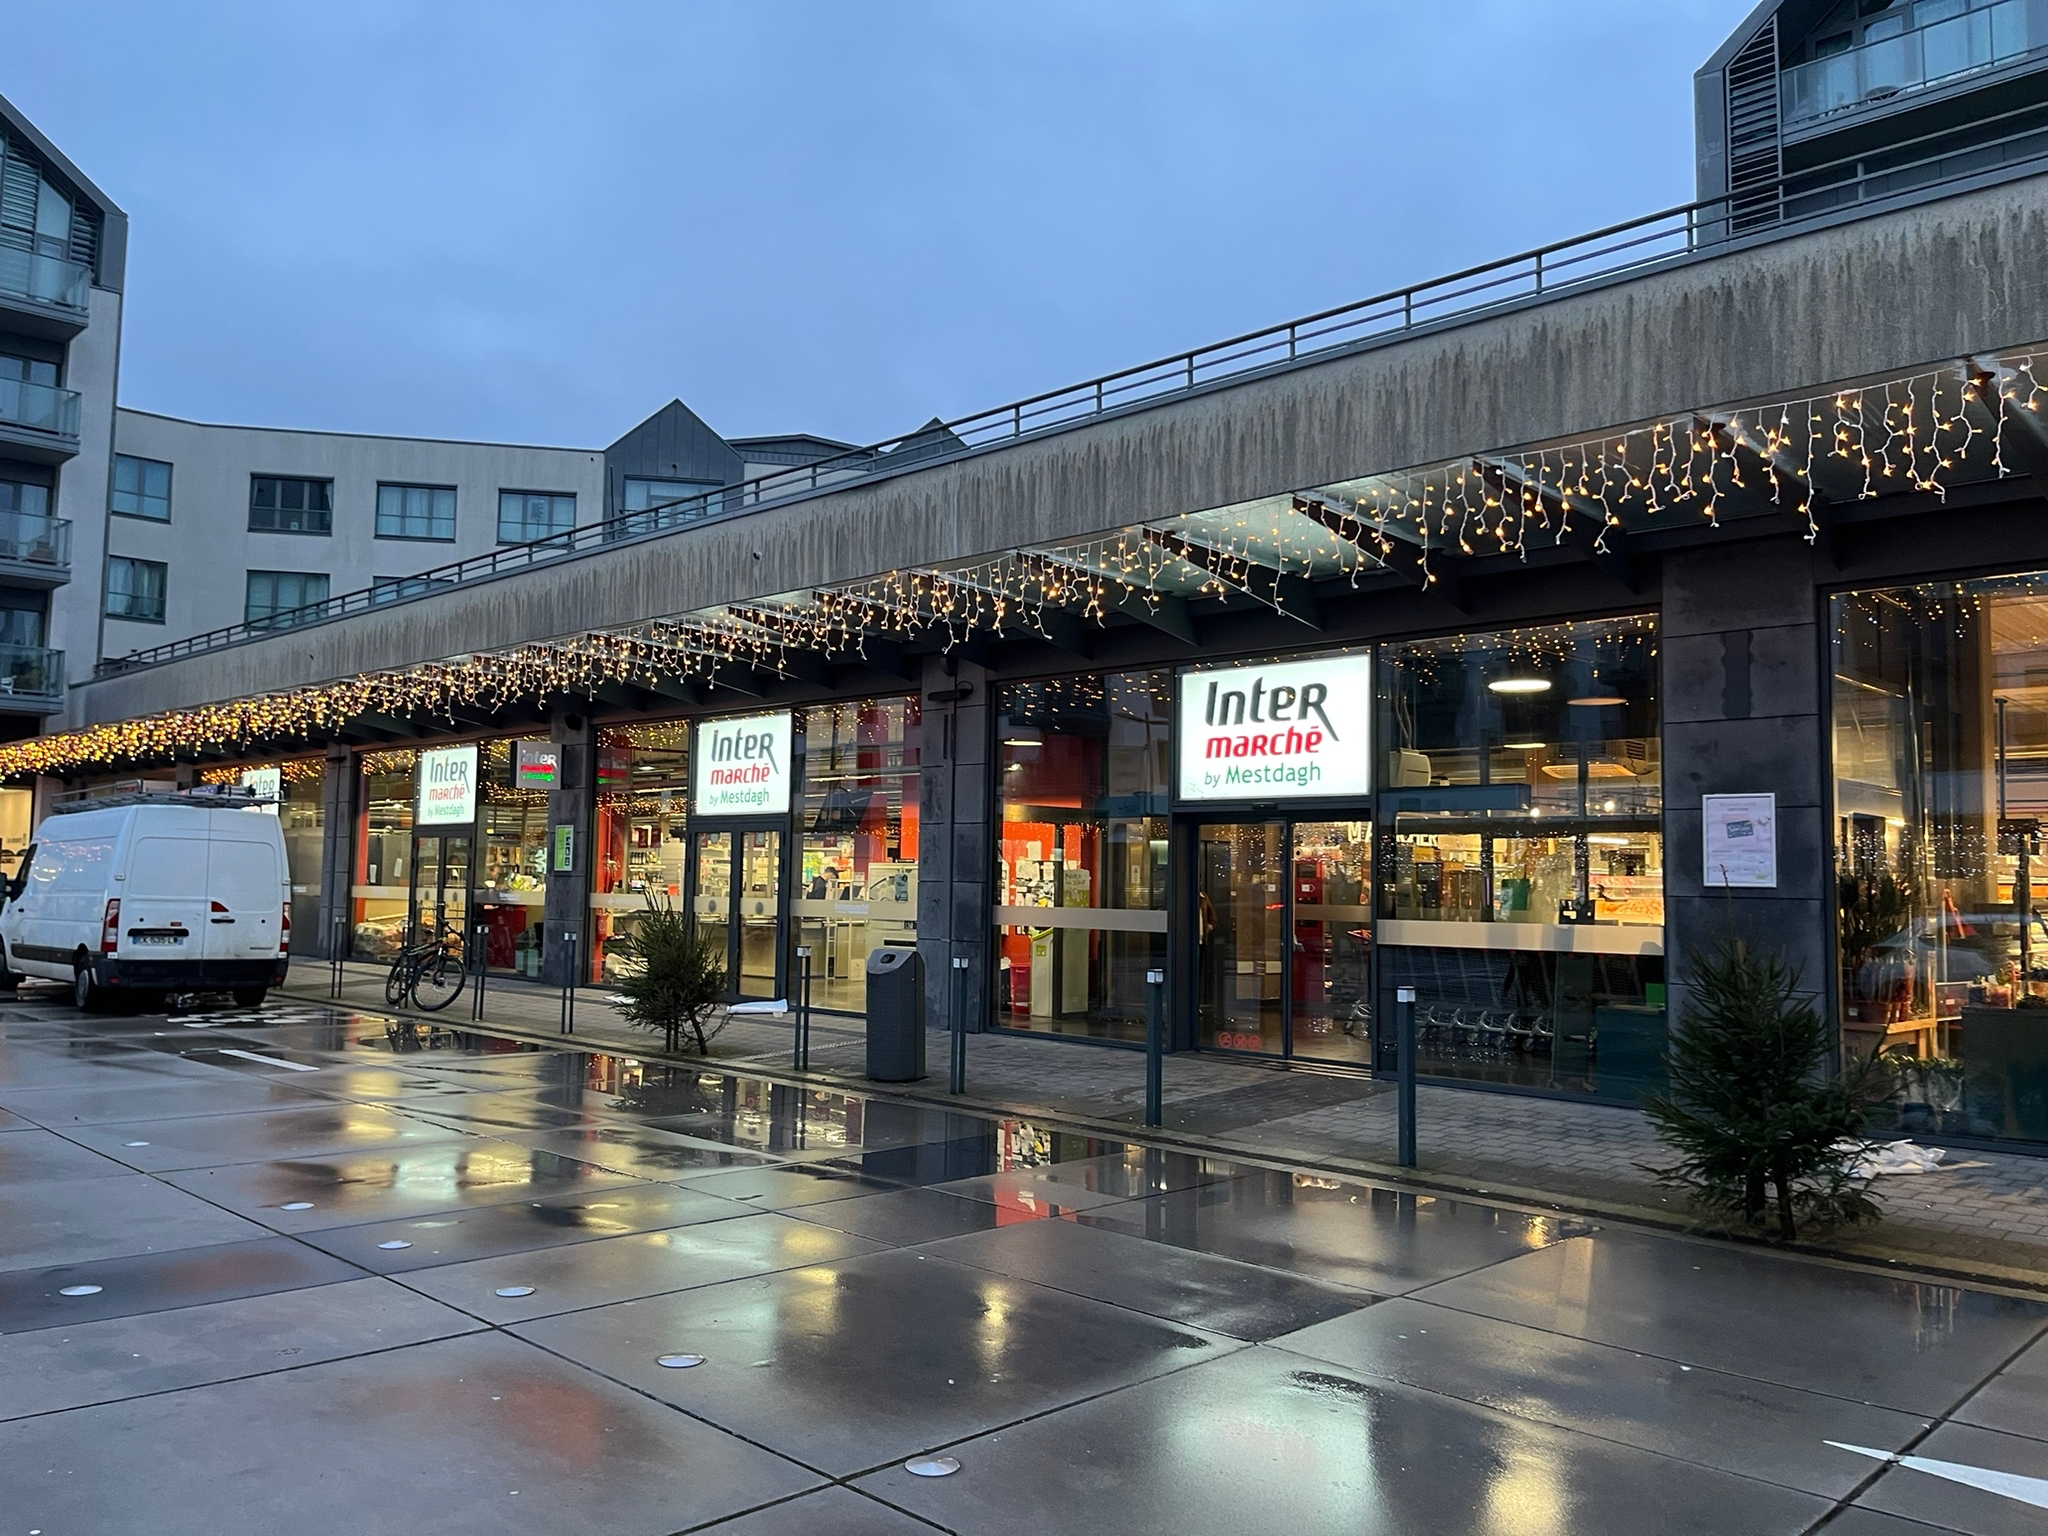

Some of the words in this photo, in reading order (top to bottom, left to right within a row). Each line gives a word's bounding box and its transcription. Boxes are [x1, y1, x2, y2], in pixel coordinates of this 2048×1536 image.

[1204, 772, 1221, 786] by
[1225, 761, 1321, 786] Mestdagh
[709, 794, 719, 807] by
[720, 788, 770, 806] Mestdagh
